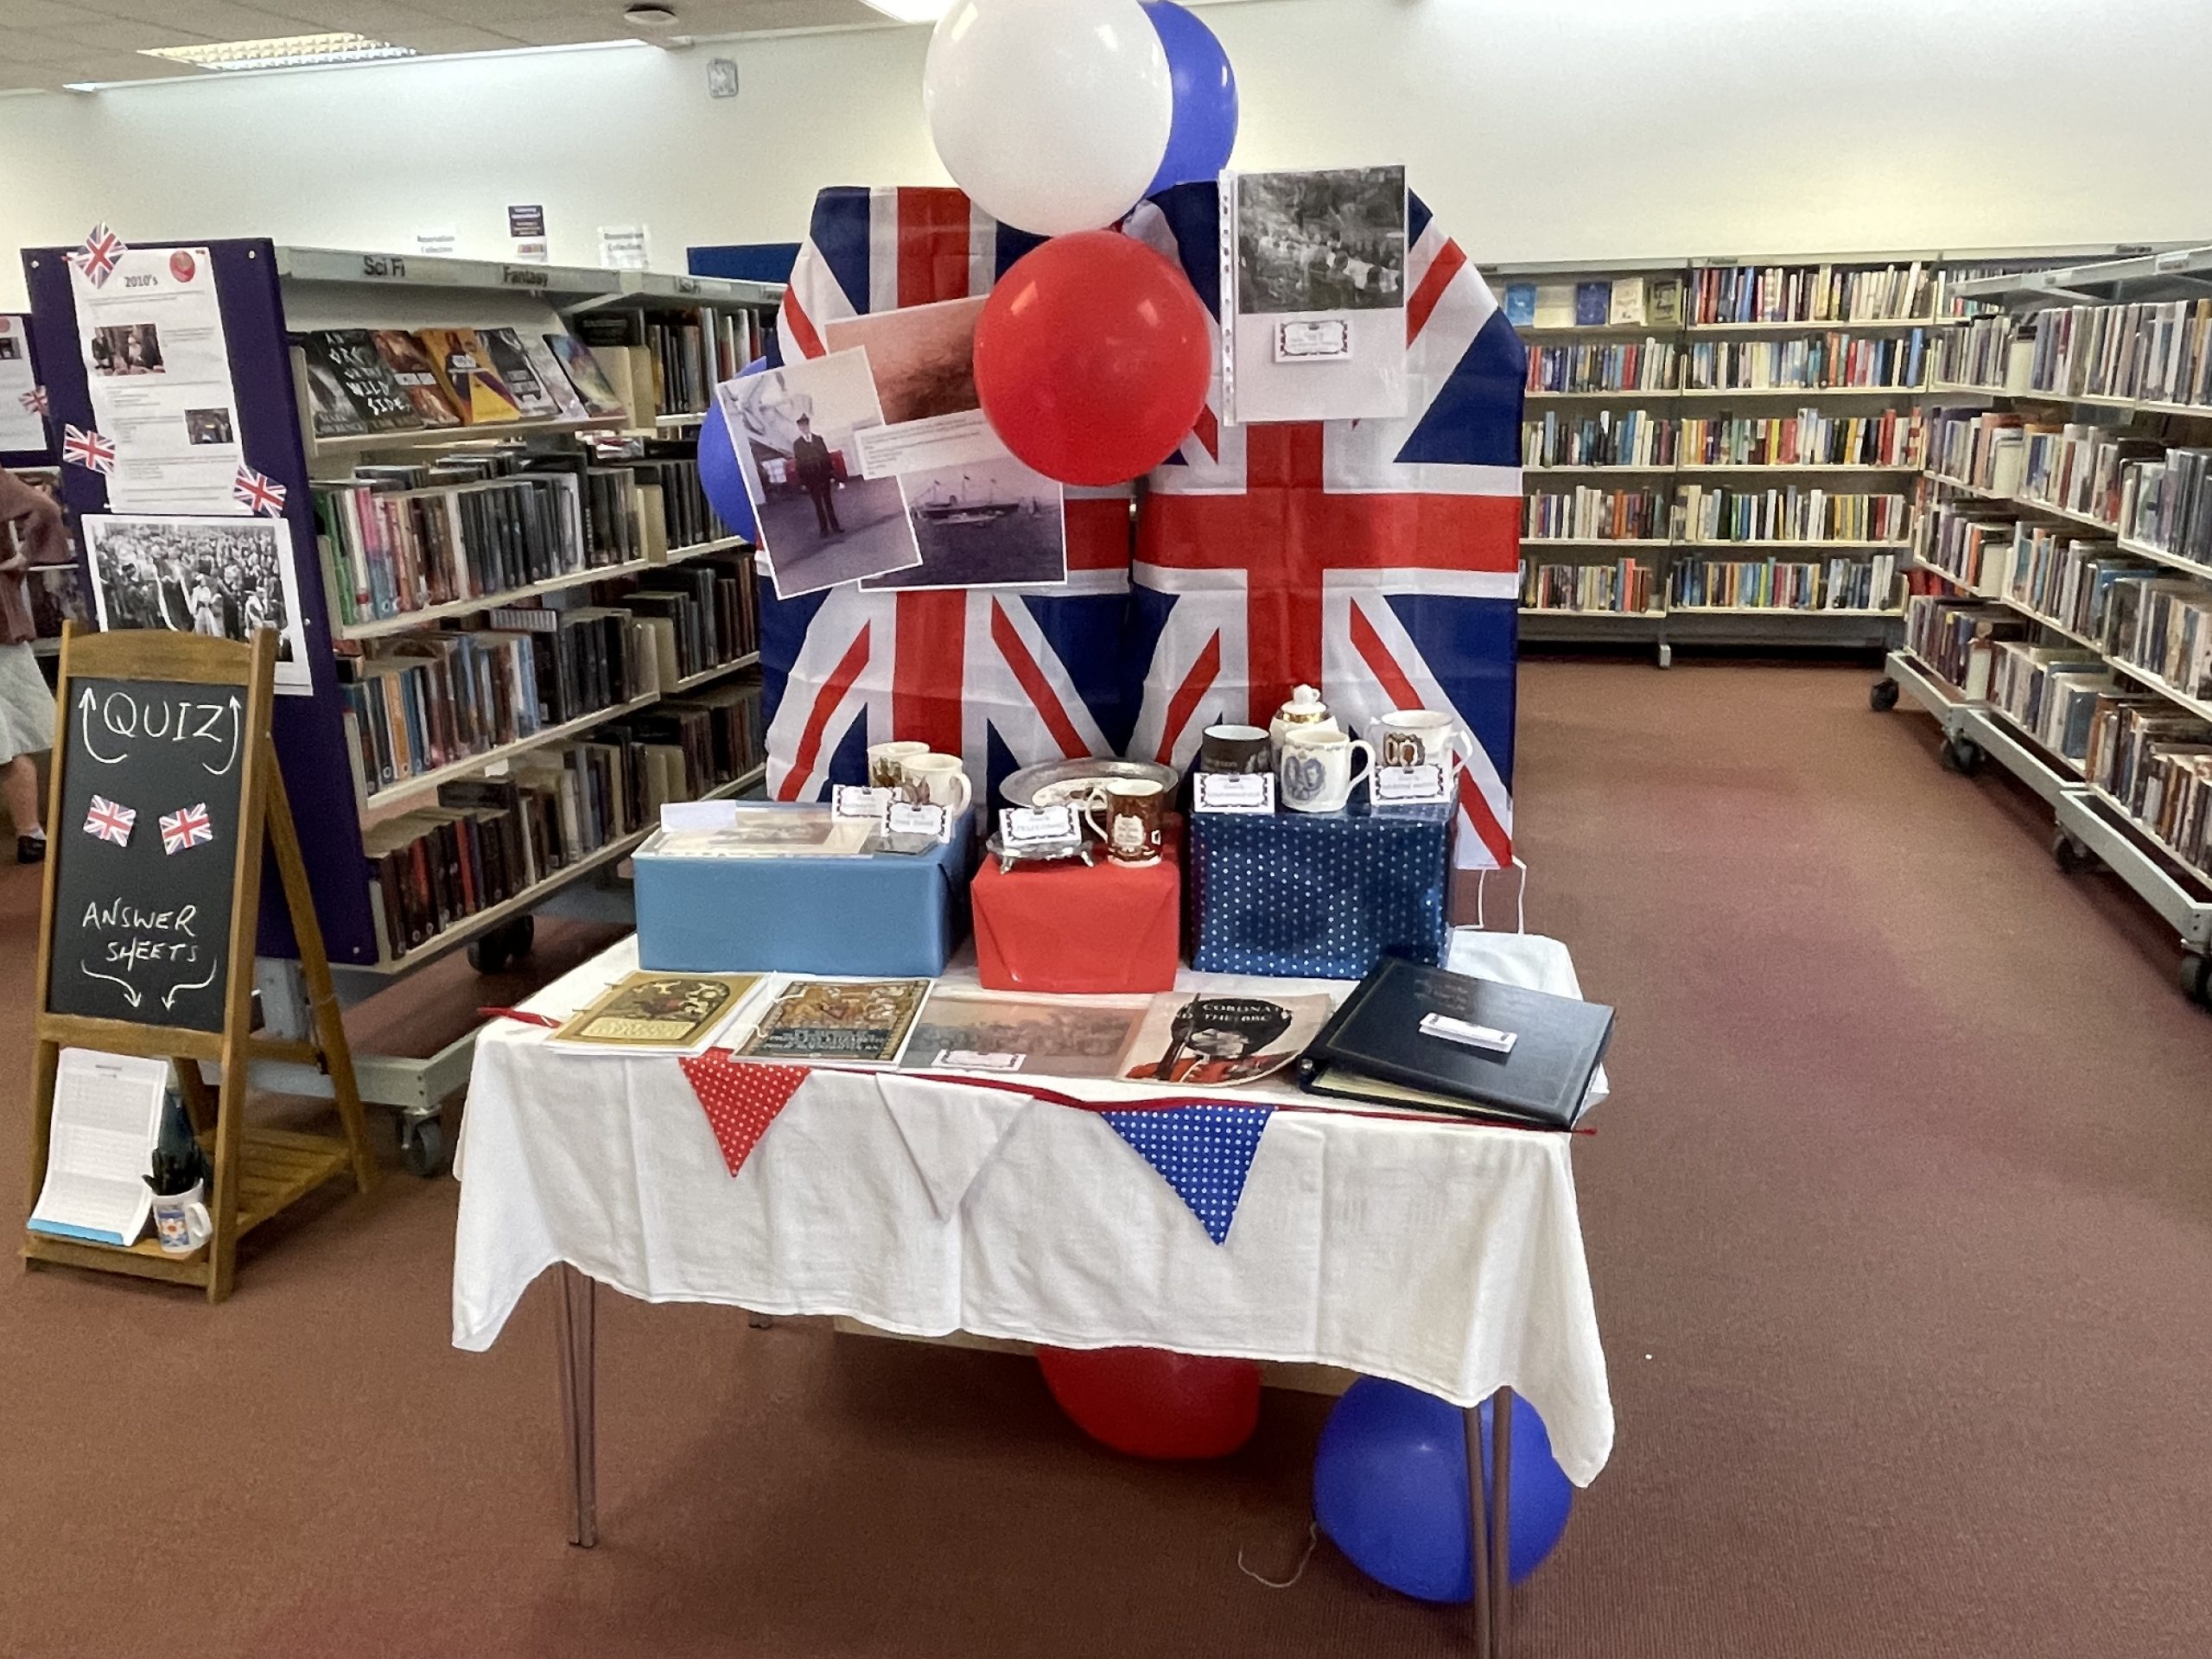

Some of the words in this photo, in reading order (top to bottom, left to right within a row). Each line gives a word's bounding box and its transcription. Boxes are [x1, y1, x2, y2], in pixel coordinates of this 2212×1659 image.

[363, 255, 388, 276] Sci
[391, 257, 406, 276] Fi
[501, 265, 549, 287] Fantasy
[124, 274, 158, 288] 2010's
[346, 380, 390, 397] WILD
[103, 691, 225, 743] QUIZ
[82, 896, 197, 938] ANSWER
[105, 936, 199, 972] SHEETS
